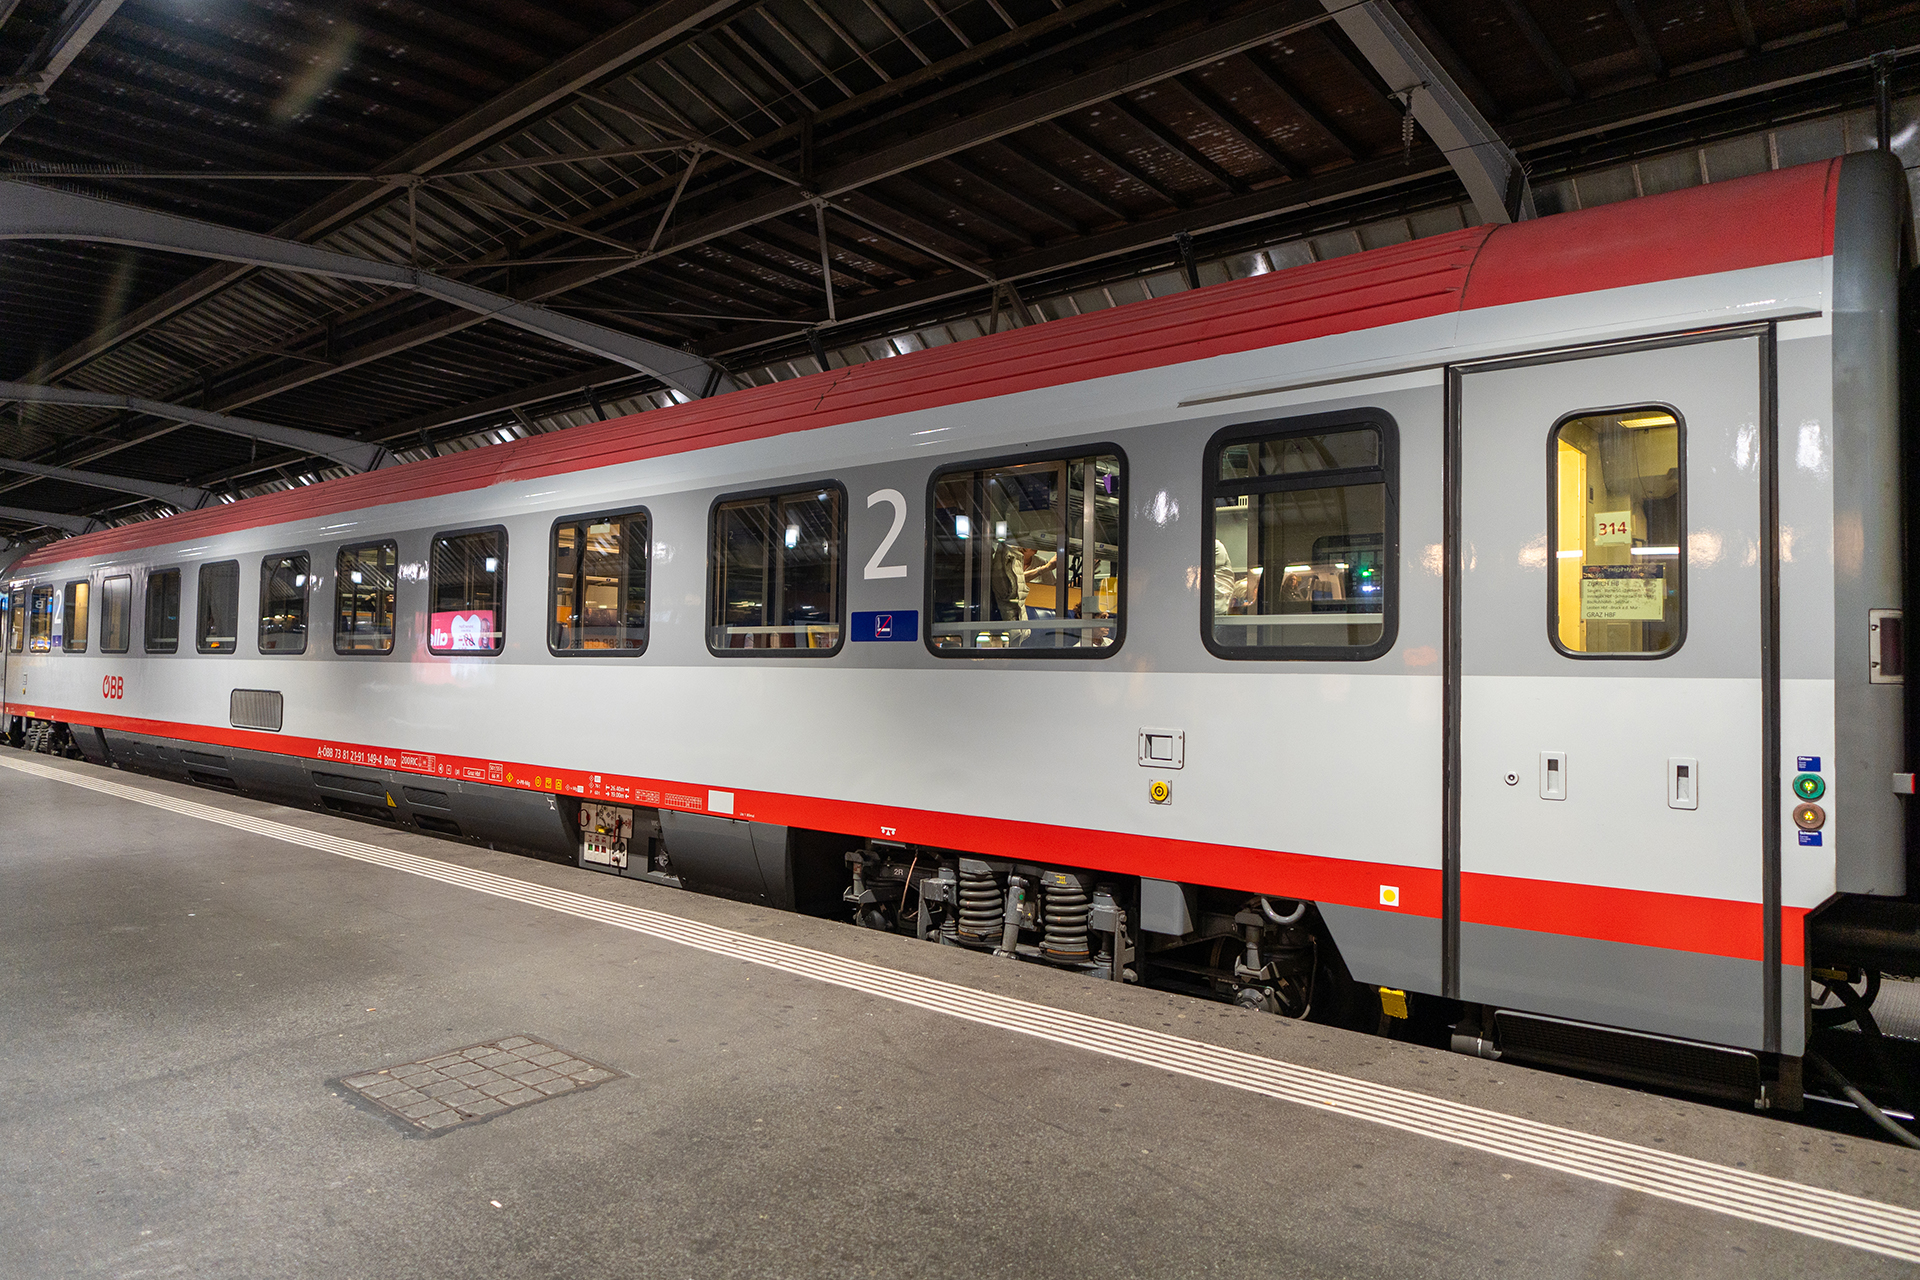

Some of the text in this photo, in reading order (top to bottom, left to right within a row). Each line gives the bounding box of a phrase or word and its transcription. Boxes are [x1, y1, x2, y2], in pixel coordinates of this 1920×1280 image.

[863, 488, 907, 580] 2
[1598, 521, 1627, 536] 314
[54, 589, 62, 624] 2
[102, 674, 124, 700] ÖBB
[334, 748, 342, 759] 73
[342, 749, 349, 760] 81
[367, 752, 382, 765] 149-4
[384, 755, 397, 767] Bmz
[893, 868, 904, 876] 2R
